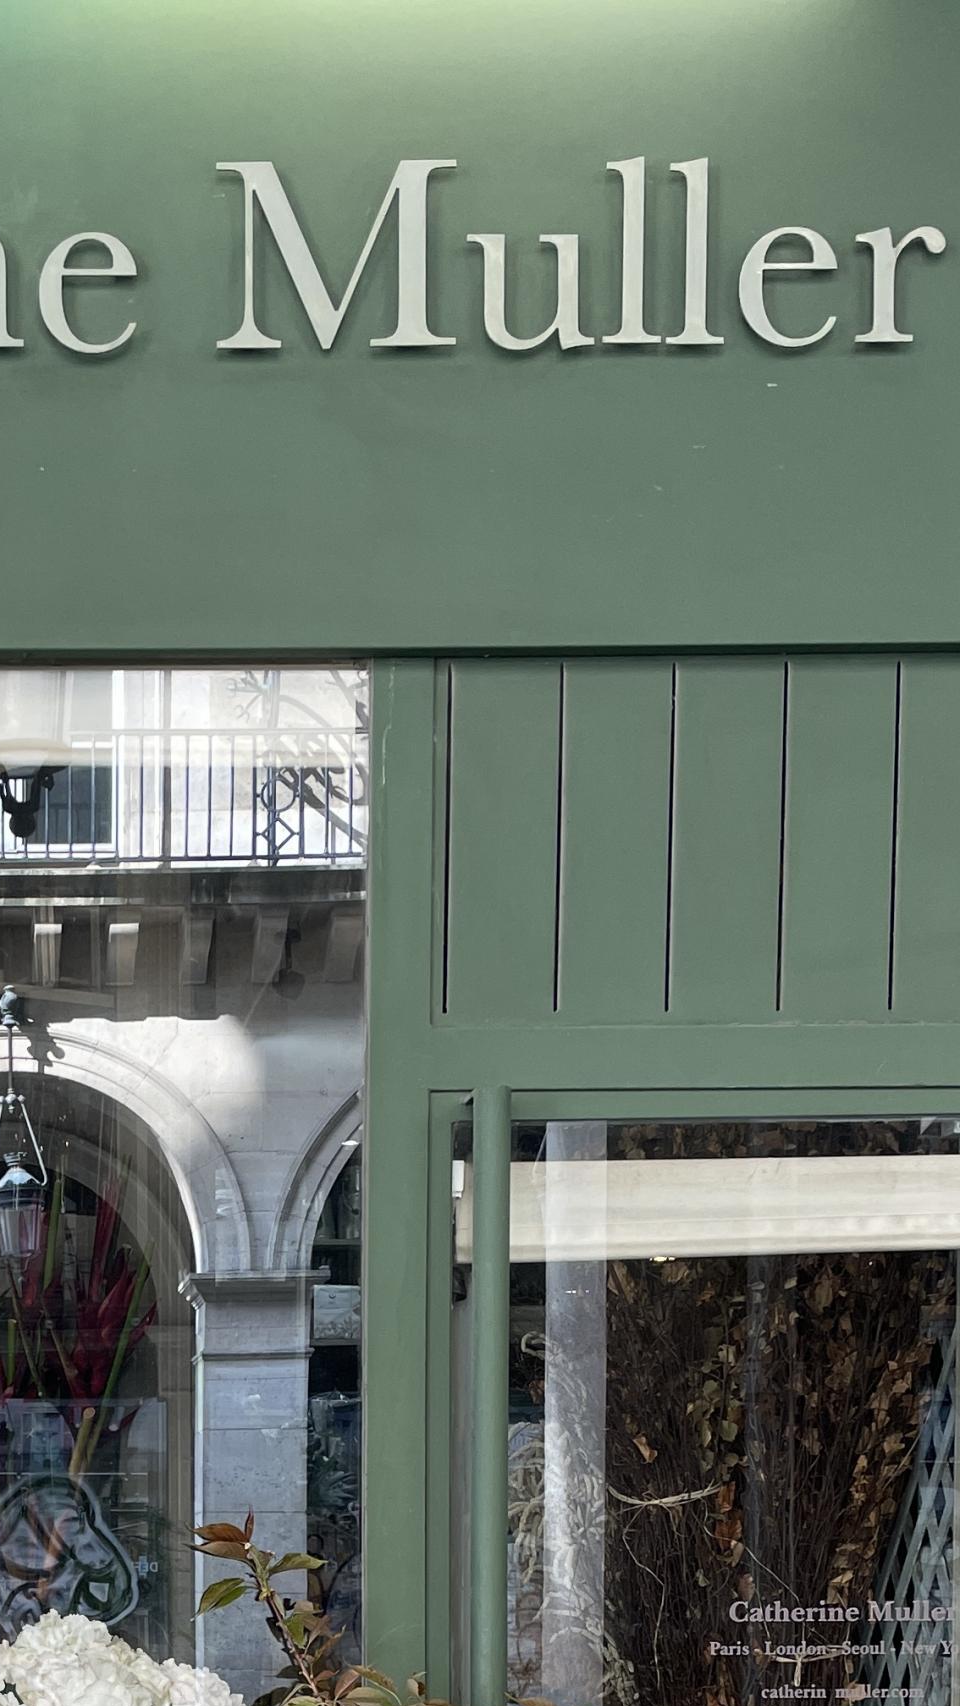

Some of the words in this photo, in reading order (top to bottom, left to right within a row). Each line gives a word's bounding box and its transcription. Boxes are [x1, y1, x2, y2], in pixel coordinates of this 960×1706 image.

[215, 155, 946, 350] Muller
[729, 1599, 859, 1622] Catherine
[867, 1599, 957, 1622] Muller
[709, 1640, 750, 1656] Paris
[764, 1640, 826, 1656] London
[841, 1640, 885, 1656] Seoul
[900, 1640, 936, 1655] New
